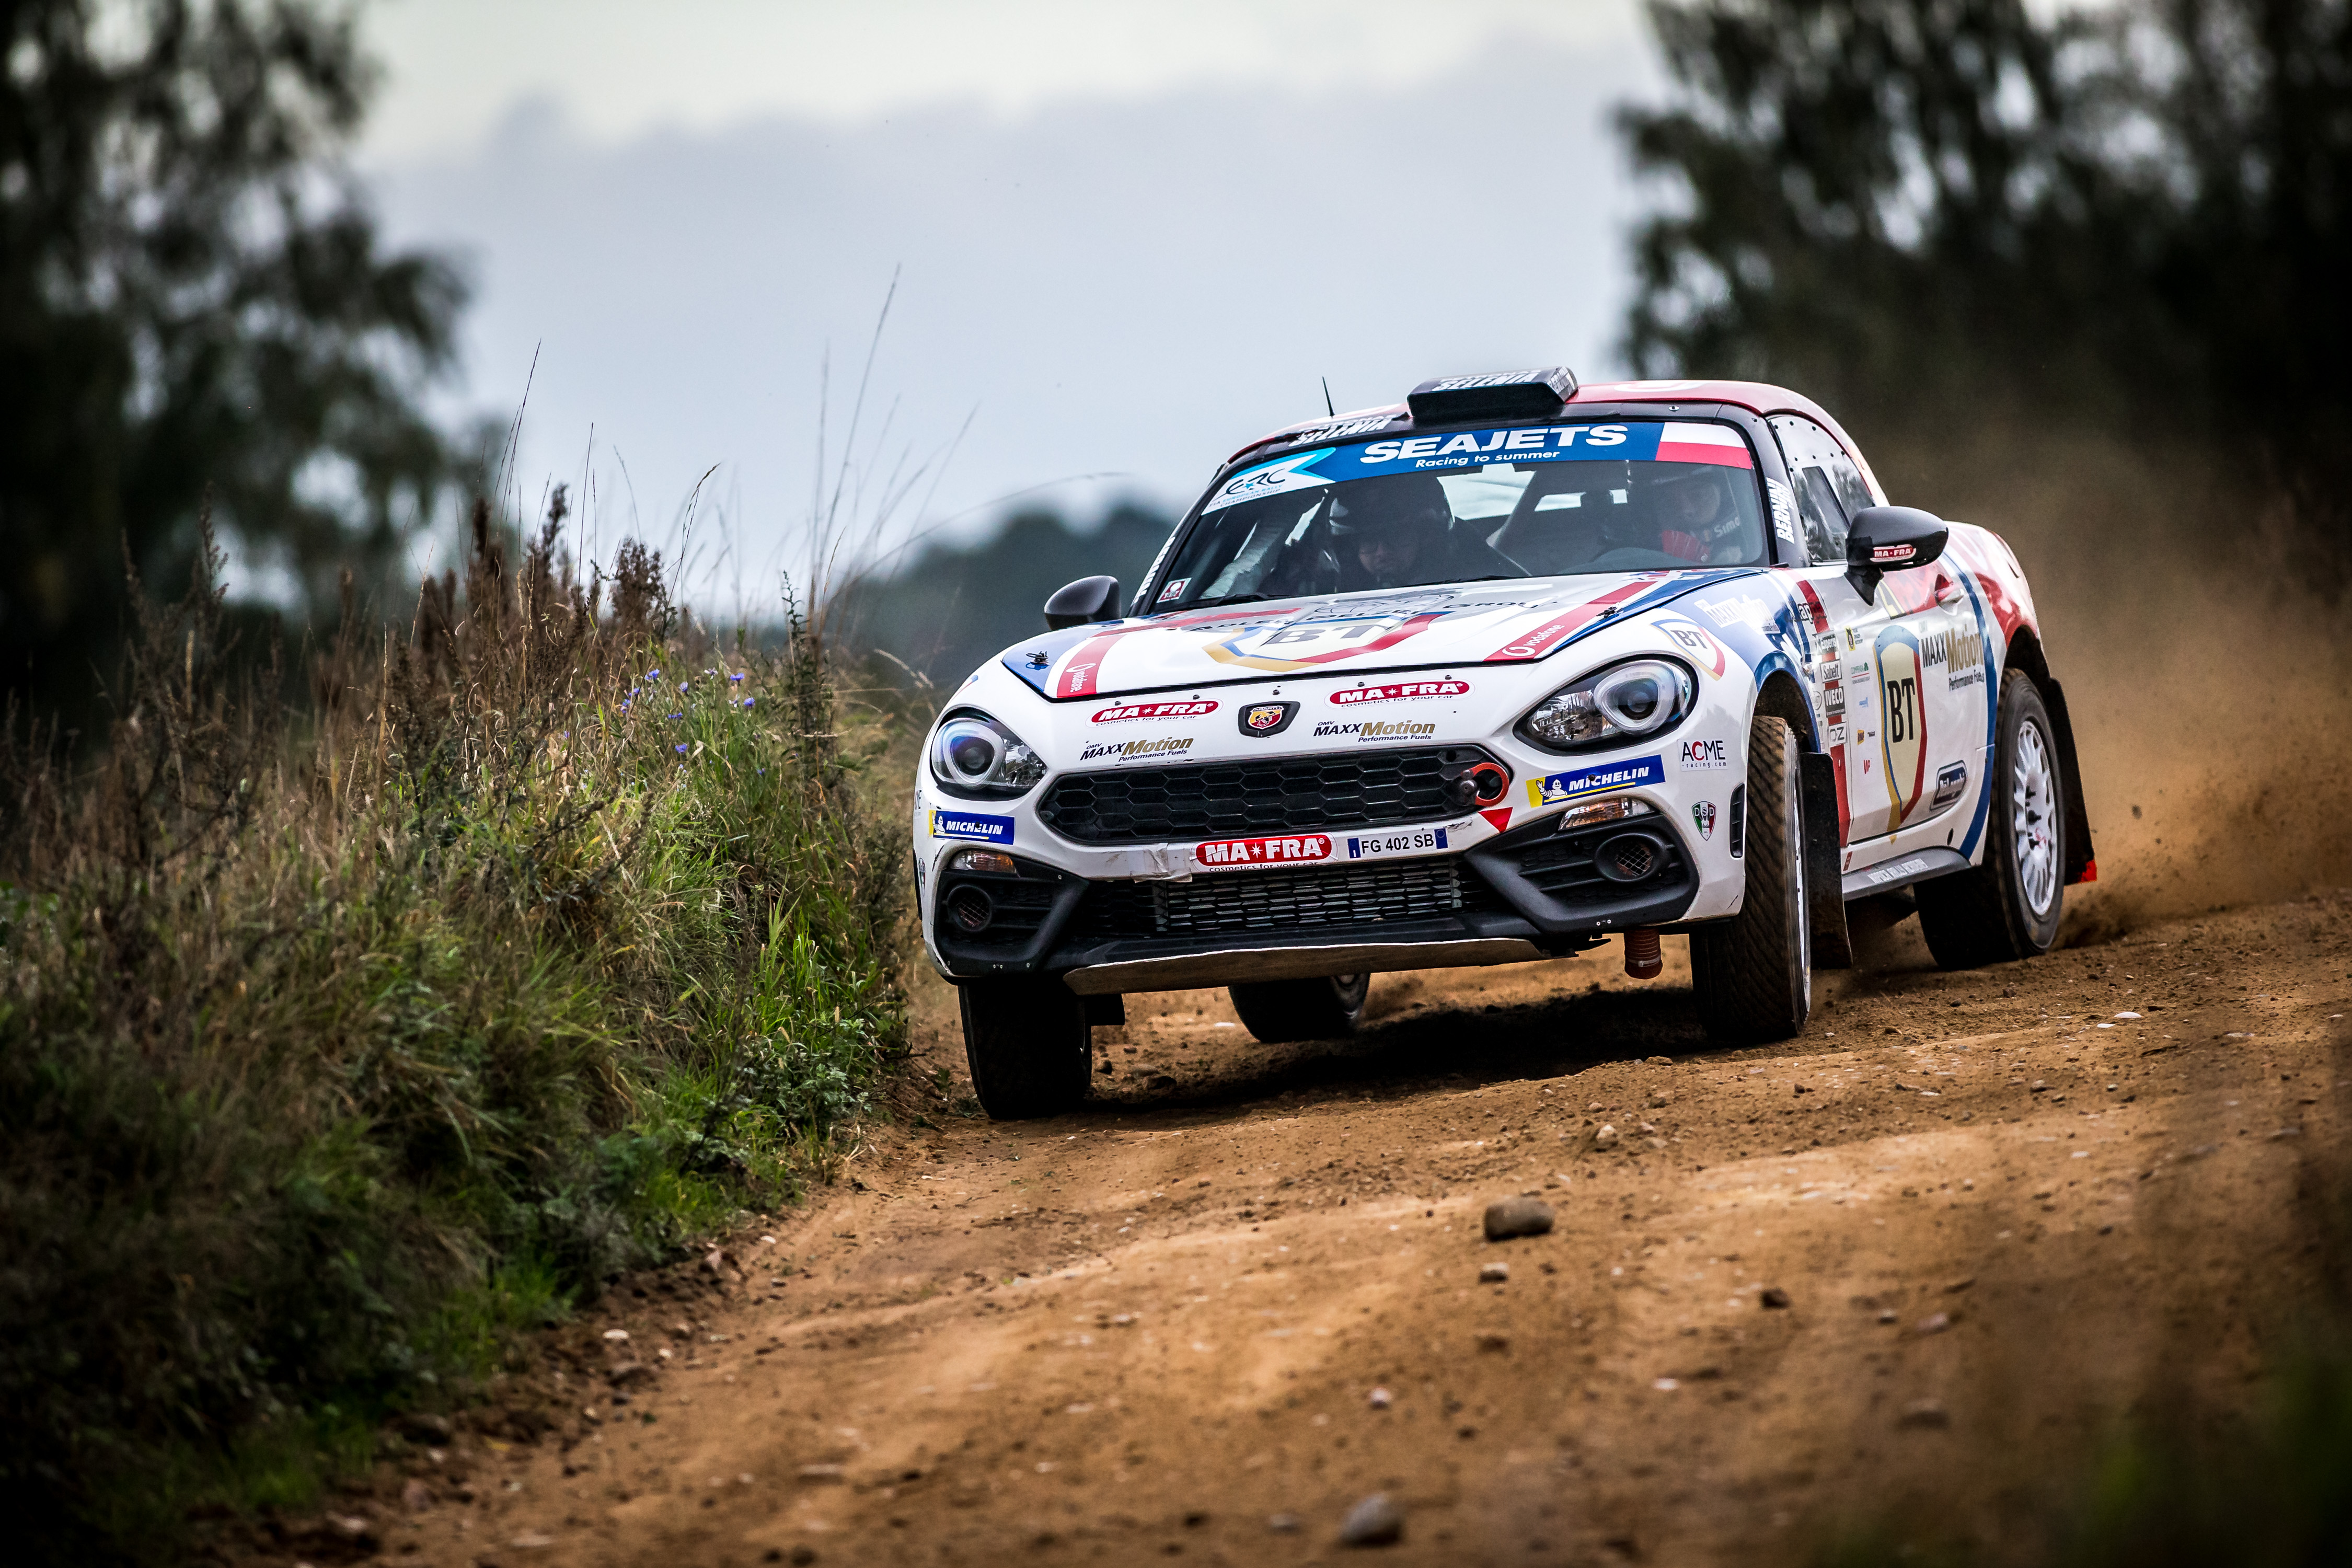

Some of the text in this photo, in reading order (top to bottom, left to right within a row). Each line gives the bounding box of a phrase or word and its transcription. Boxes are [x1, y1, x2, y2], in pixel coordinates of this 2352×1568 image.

[1360, 425, 1629, 463] SEAJETS
[1415, 456, 1469, 468] Racing
[1495, 451, 1560, 461] summer
[1220, 489, 1281, 508] CHAMPIONSHIP
[1223, 490, 1260, 503] EUROPEAN
[1265, 624, 1394, 644] BT
[1523, 624, 1565, 647] vodafone
[1670, 630, 1708, 649] BT
[1823, 663, 1839, 680] Sabelt
[1070, 670, 1086, 693] vodafone
[1341, 699, 1390, 708] cosmetics
[1825, 687, 1844, 706] IVECO
[1887, 677, 1916, 743] BT
[1096, 718, 1139, 727] cosmetics
[1829, 726, 1845, 742] OZ
[1118, 752, 1166, 762] Performance
[1681, 740, 1726, 762] ACME
[1569, 766, 1650, 791] MICHELIN
[1694, 806, 1714, 816] DSD
[946, 821, 1004, 835] MICHELIN
[1361, 839, 1381, 854] FG
[1386, 836, 1410, 851] 402
[1414, 834, 1434, 848] SB
